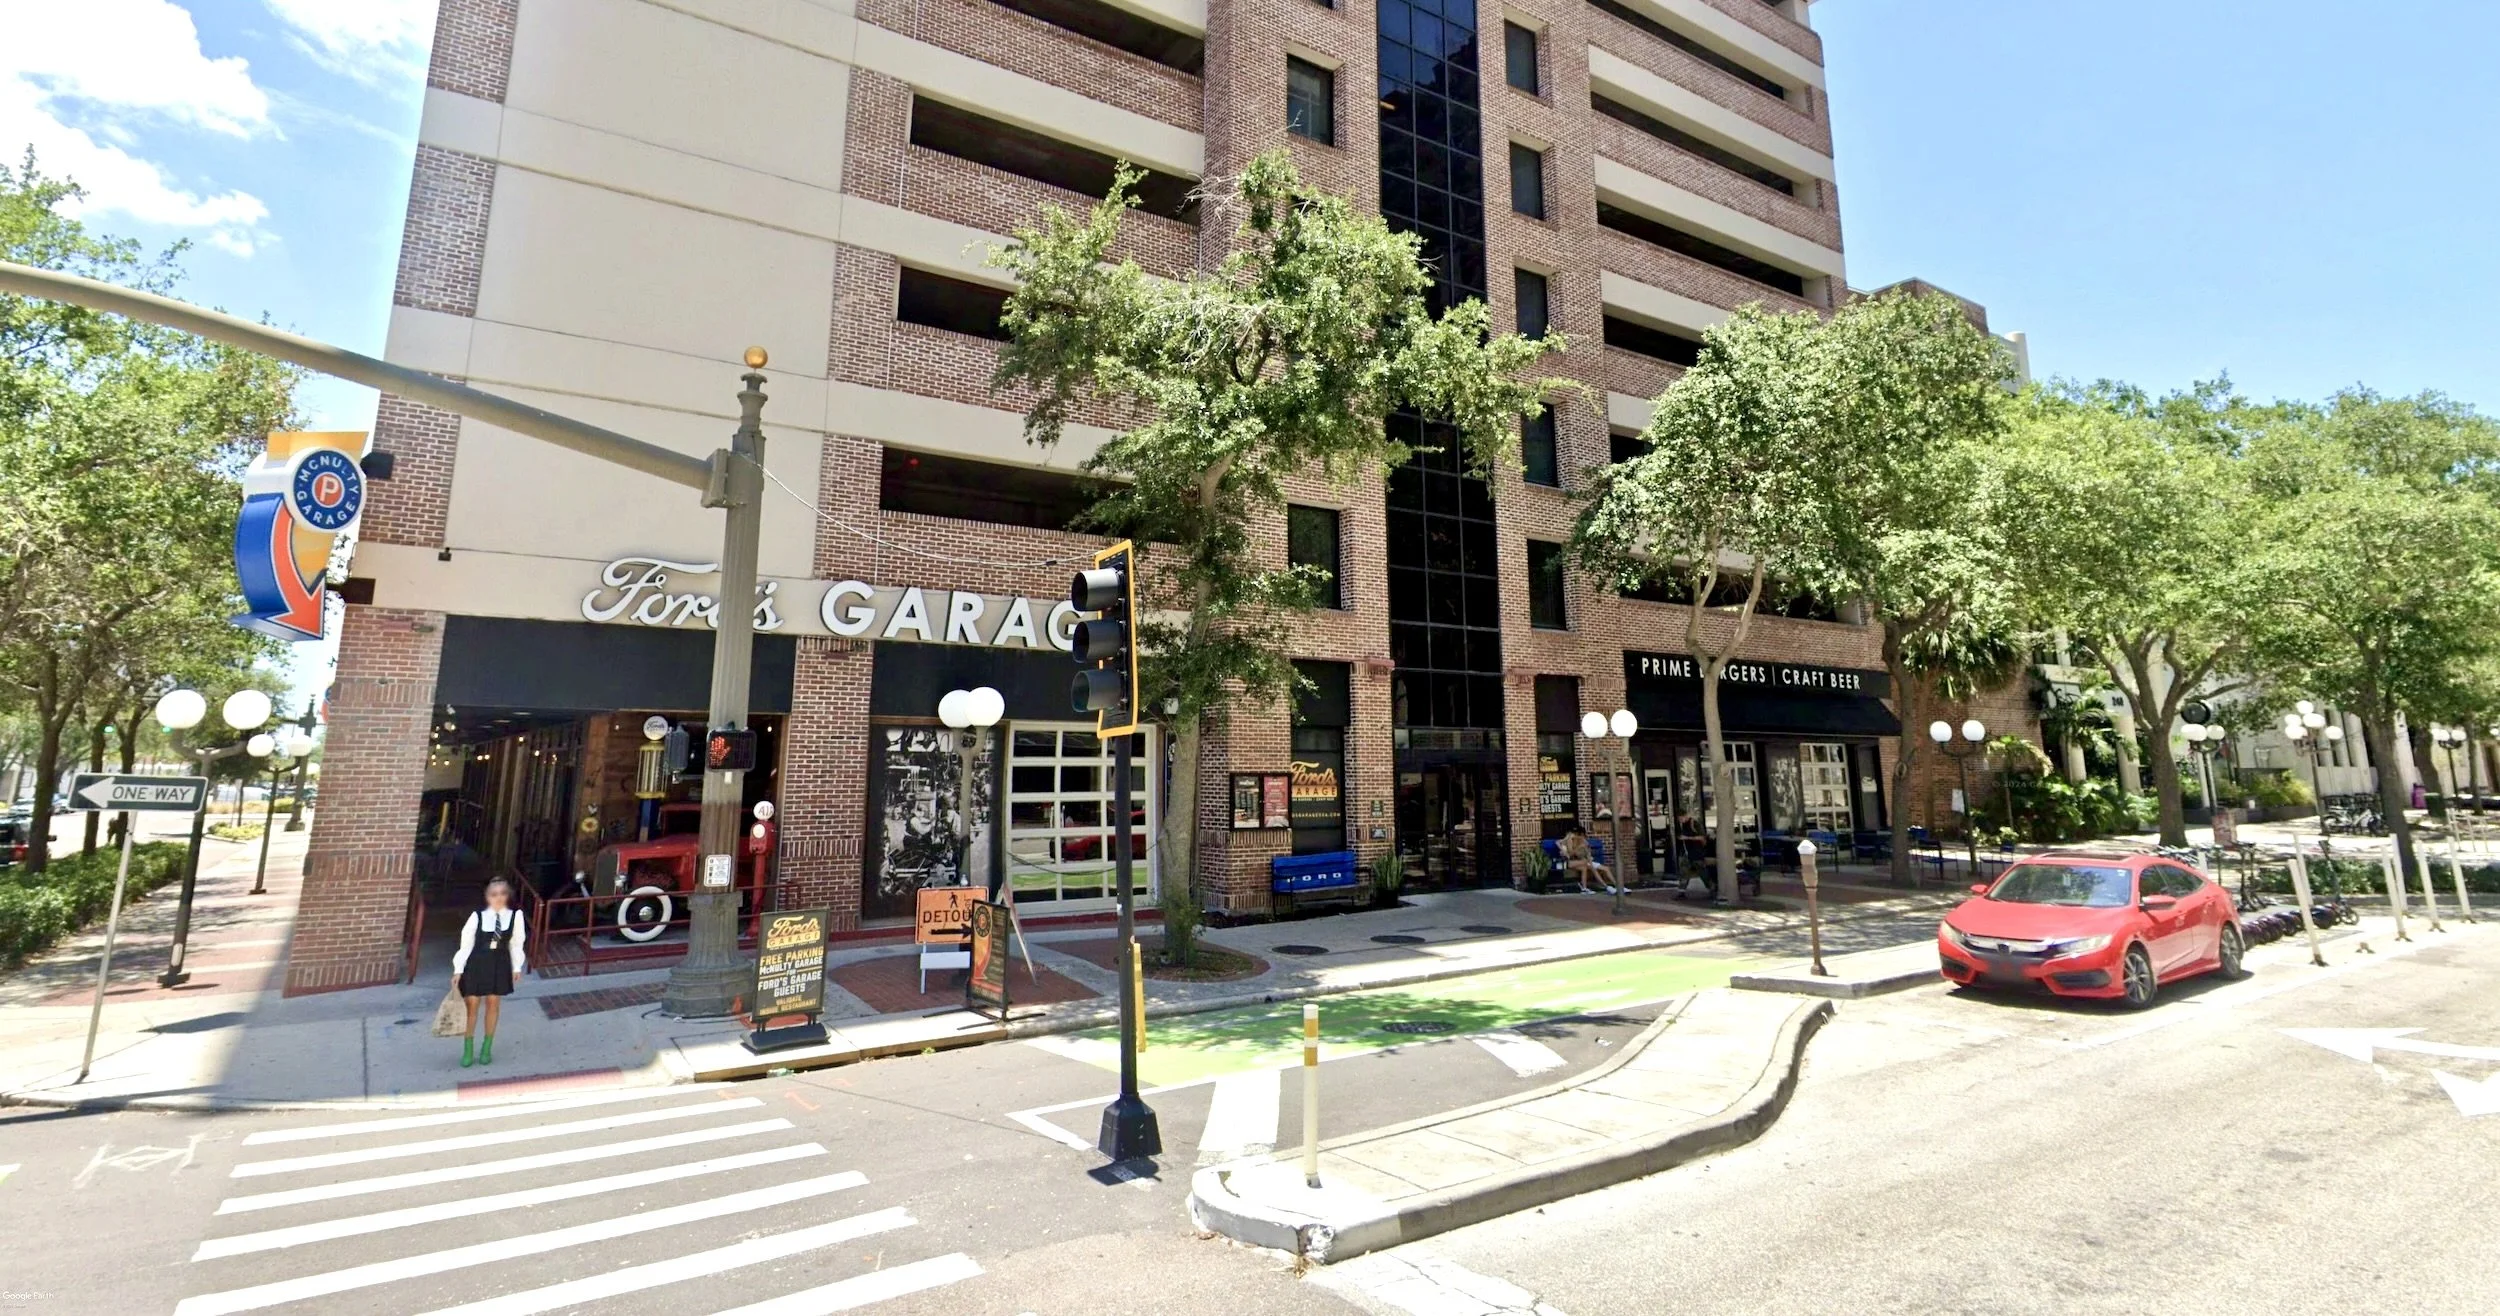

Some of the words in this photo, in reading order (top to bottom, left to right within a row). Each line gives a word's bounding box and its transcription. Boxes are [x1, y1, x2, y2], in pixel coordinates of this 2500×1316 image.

[320, 475, 339, 502] P
[296, 490, 356, 525] GARAGE
[821, 580, 1086, 652] GARAG
[1641, 657, 1692, 678] PRIME
[1699, 664, 1766, 683] RGERS
[1782, 668, 1824, 688] CRAFT
[1830, 672, 1861, 690] BEER
[112, 786, 148, 800] ONE
[155, 787, 192, 801] WAY
[1296, 787, 1336, 796] ARAGE
[923, 909, 972, 924] DETOU
[768, 932, 819, 947] GARAGE
[760, 953, 782, 966] FREE
[786, 946, 824, 962] PARKING
[795, 956, 823, 969] GARAGE
[758, 977, 788, 991] FORD'S
[790, 970, 822, 986] GARAGE
[774, 983, 805, 997] GUESTS
